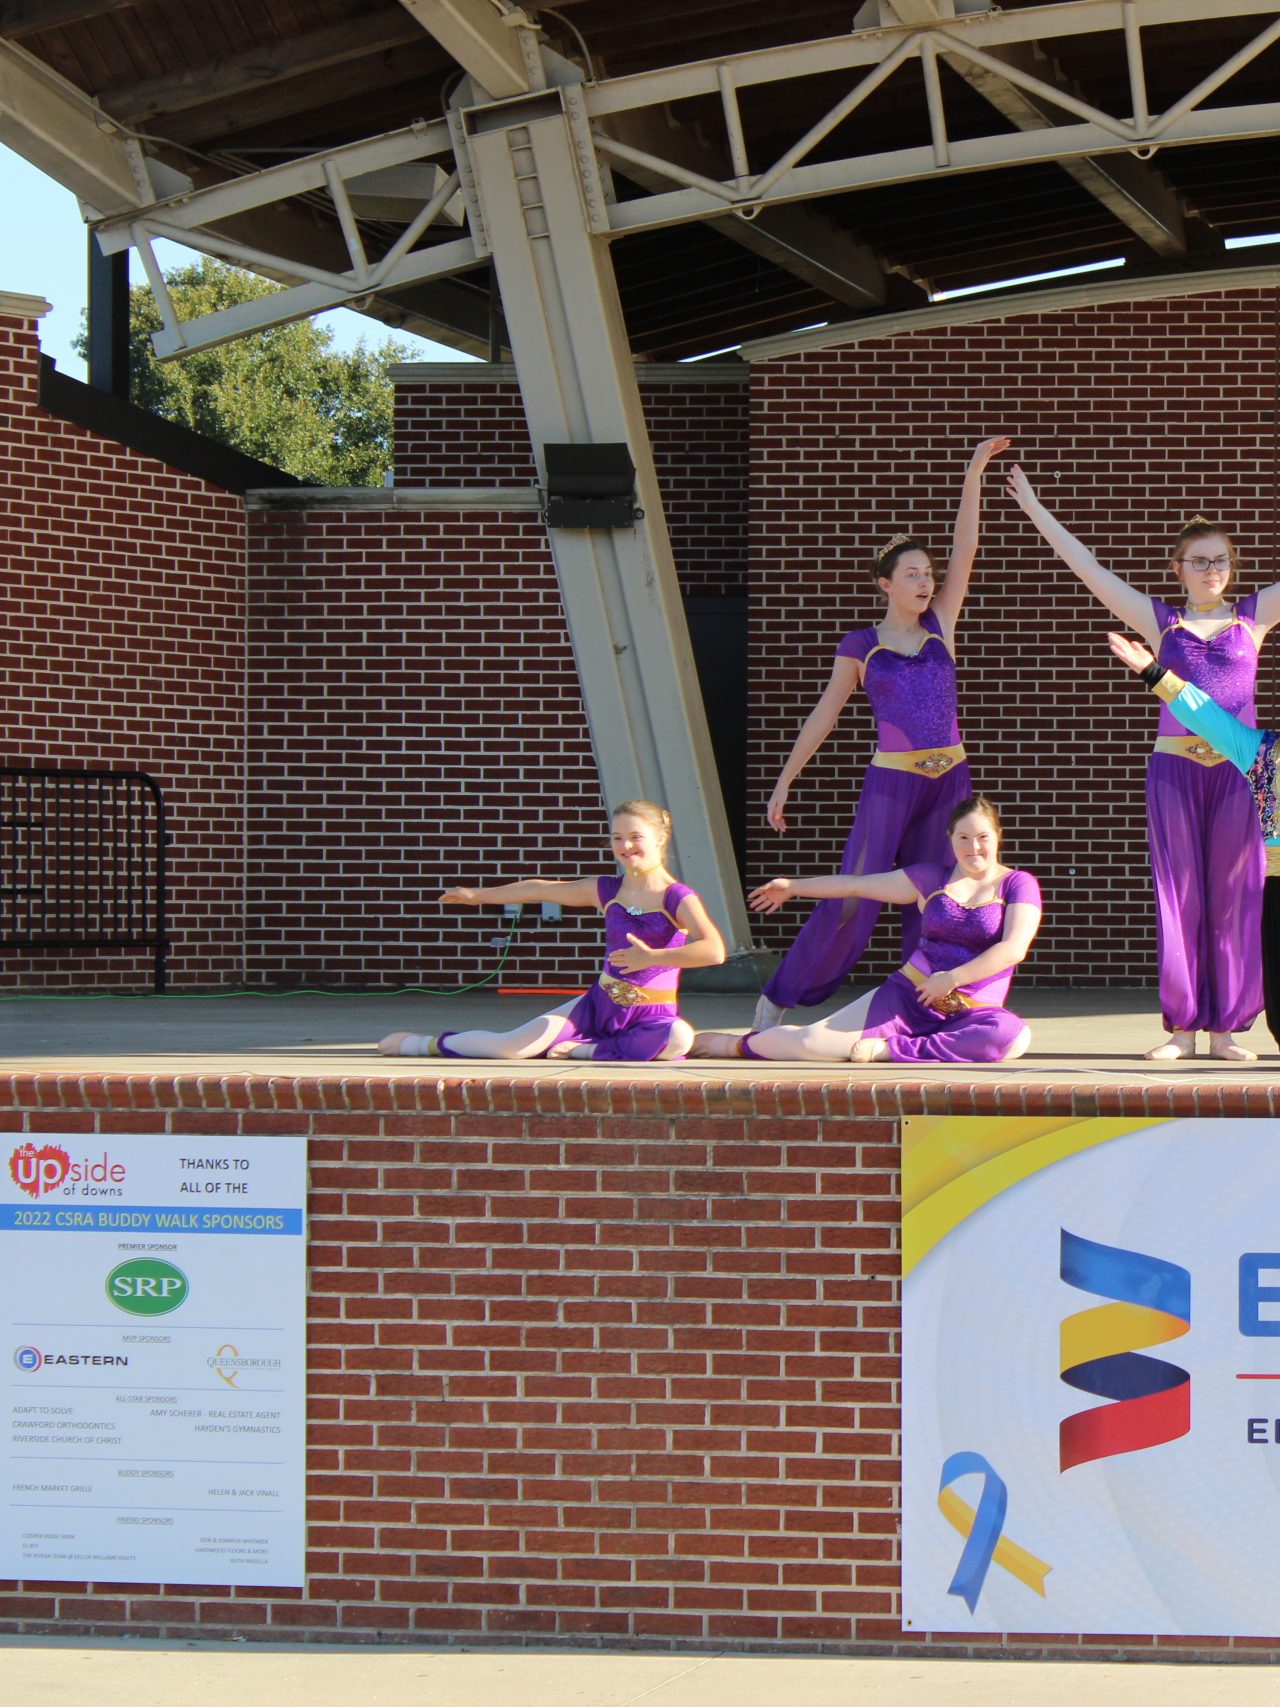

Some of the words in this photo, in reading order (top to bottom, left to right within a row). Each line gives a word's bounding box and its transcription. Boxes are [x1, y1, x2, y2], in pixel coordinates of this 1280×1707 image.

[20, 1149, 35, 1158] the
[179, 1158, 230, 1170] THANKS
[233, 1159, 250, 1171] TO
[63, 1183, 77, 1196] of
[81, 1183, 123, 1197] downs
[180, 1182, 202, 1193] ALL
[205, 1182, 221, 1193] OF
[225, 1182, 248, 1194] THE
[14, 1211, 51, 1226] 2022
[55, 1211, 94, 1227] CSRA
[98, 1212, 151, 1228] BUDDY
[155, 1213, 198, 1229] WALK
[202, 1214, 284, 1230] SPONSORS
[147, 1243, 178, 1251] SPONSOR
[113, 1276, 182, 1297] SRP
[122, 1335, 138, 1343] MVP
[139, 1335, 172, 1344] SPONSORS
[43, 1354, 129, 1366] EASTERN
[206, 1357, 281, 1369] QUEENSBOROUGH
[144, 1396, 178, 1404] SPONSORS
[12, 1406, 37, 1414] ADAPT
[39, 1406, 49, 1414] TO
[50, 1407, 73, 1415] SOLVE
[150, 1409, 167, 1417] AMY
[169, 1410, 202, 1418] SCHERER
[208, 1410, 226, 1418] REAL
[228, 1411, 254, 1419] ESTATE
[255, 1411, 281, 1419] AGENT
[12, 1420, 55, 1429] CRAWFORD
[56, 1421, 116, 1430] ORTHODONTICS
[194, 1425, 231, 1433] HAYDEN'S
[232, 1425, 281, 1434] GYMNASTICS
[12, 1434, 49, 1443] RIVERSIDE
[51, 1435, 82, 1444] CHURCH
[84, 1436, 94, 1444] OF
[95, 1436, 122, 1445] CHRIST
[12, 1483, 39, 1492] FRENCH
[40, 1484, 68, 1492] MARKET
[70, 1485, 92, 1493] GRILLE
[208, 1488, 230, 1496] HELEN
[238, 1489, 254, 1497] JACK
